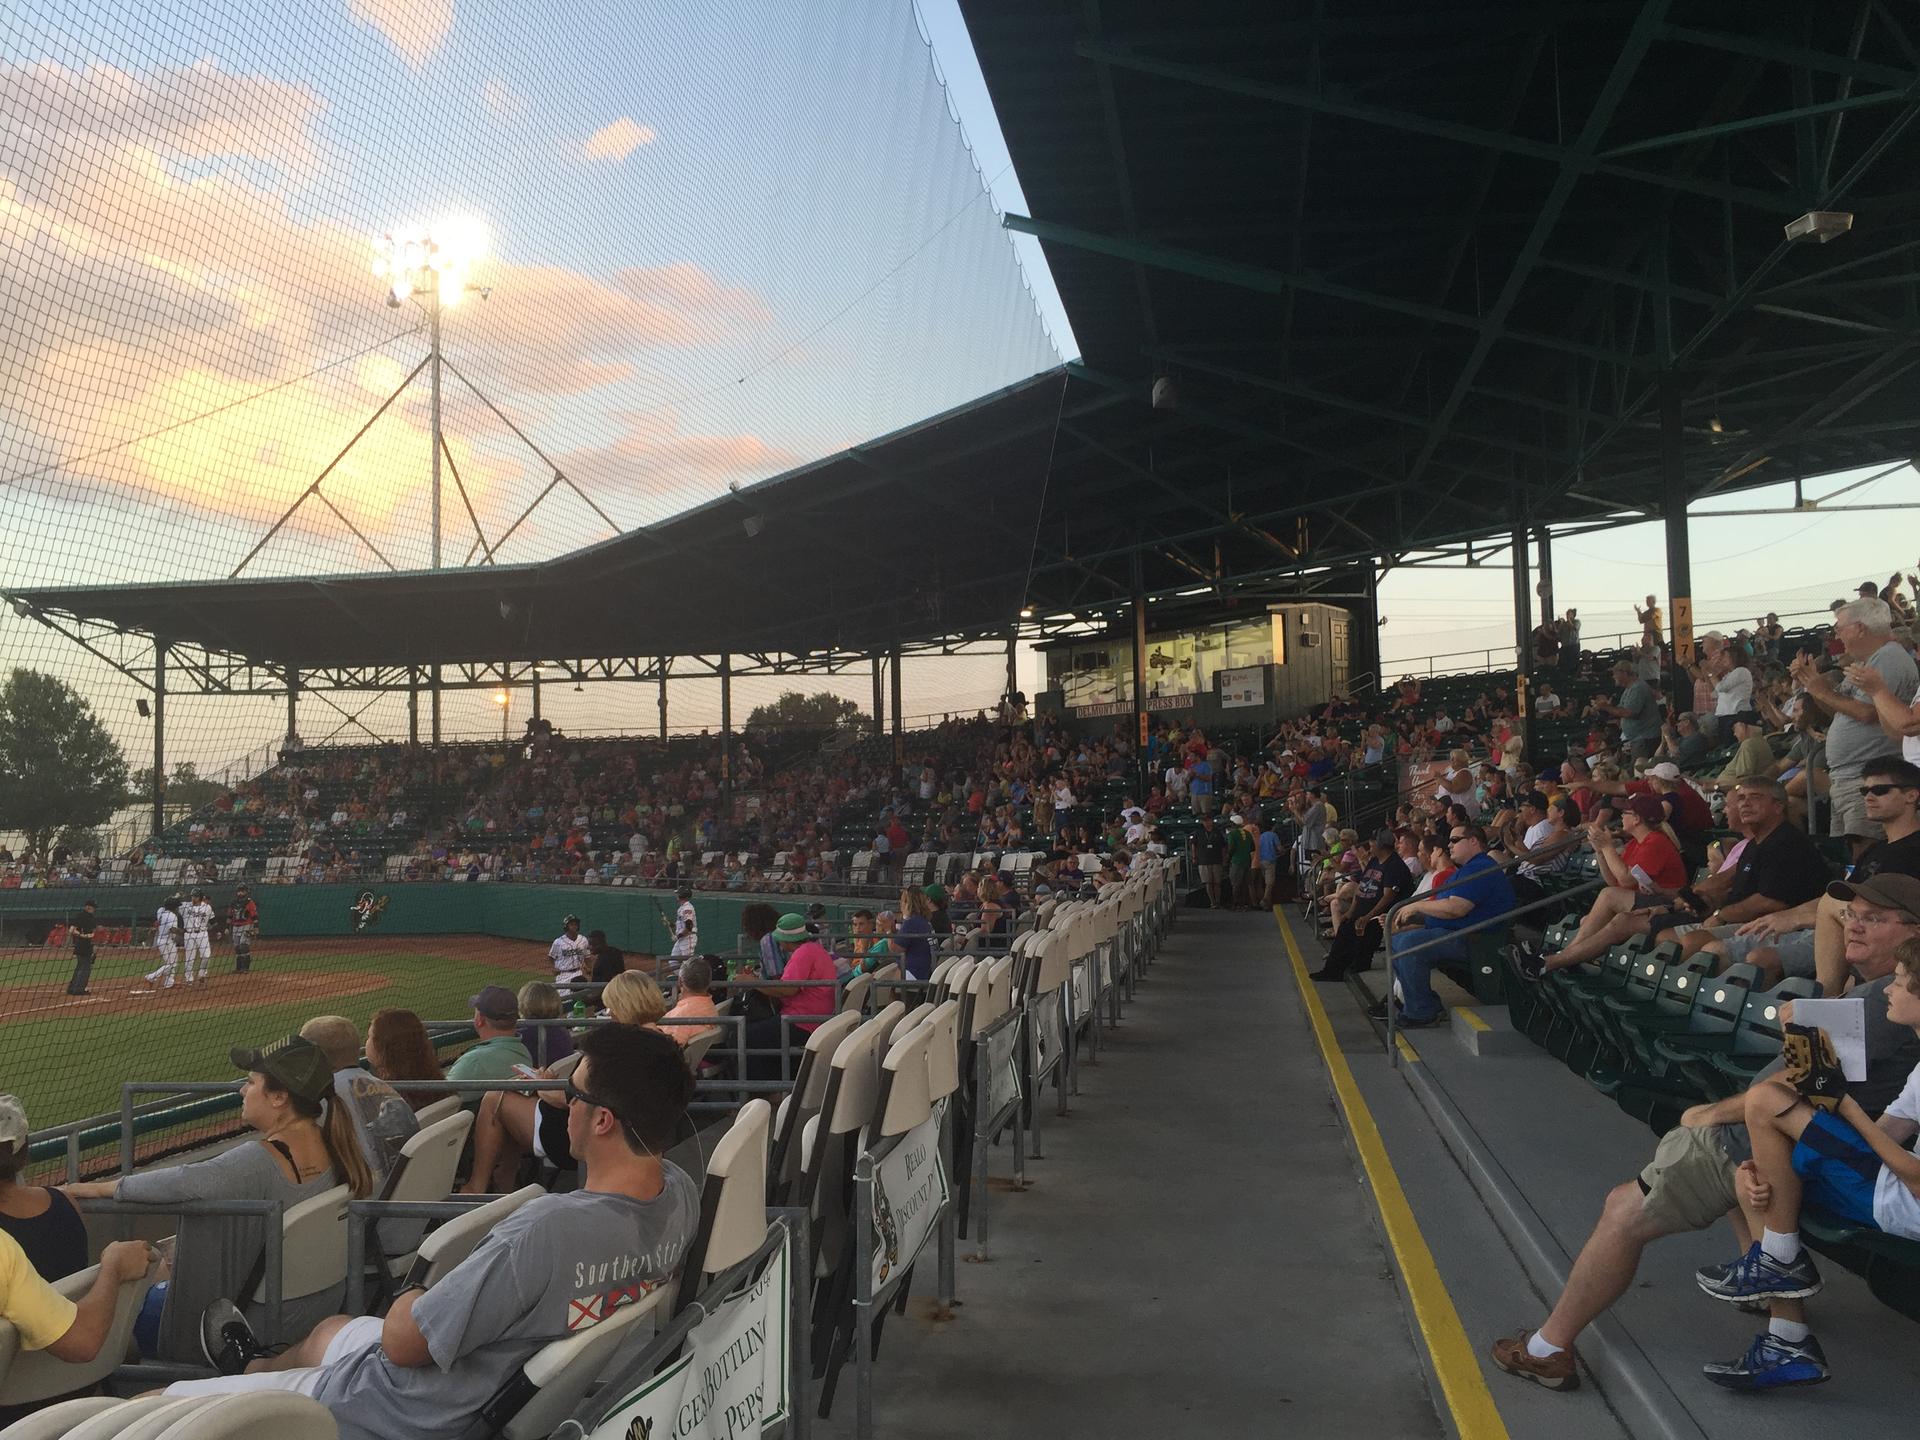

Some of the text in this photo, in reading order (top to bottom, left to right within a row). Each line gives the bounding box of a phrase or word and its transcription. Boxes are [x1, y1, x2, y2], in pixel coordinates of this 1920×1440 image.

[1679, 605, 1687, 617] 7
[1680, 643, 1689, 655] 7
[1078, 703, 1113, 717] DELMONT
[1147, 697, 1173, 711] PRESS
[1175, 695, 1192, 707] BOX
[904, 1143, 927, 1181] REALO
[895, 1182, 929, 1228] DISCOUNT
[575, 1253, 652, 1289] Southern
